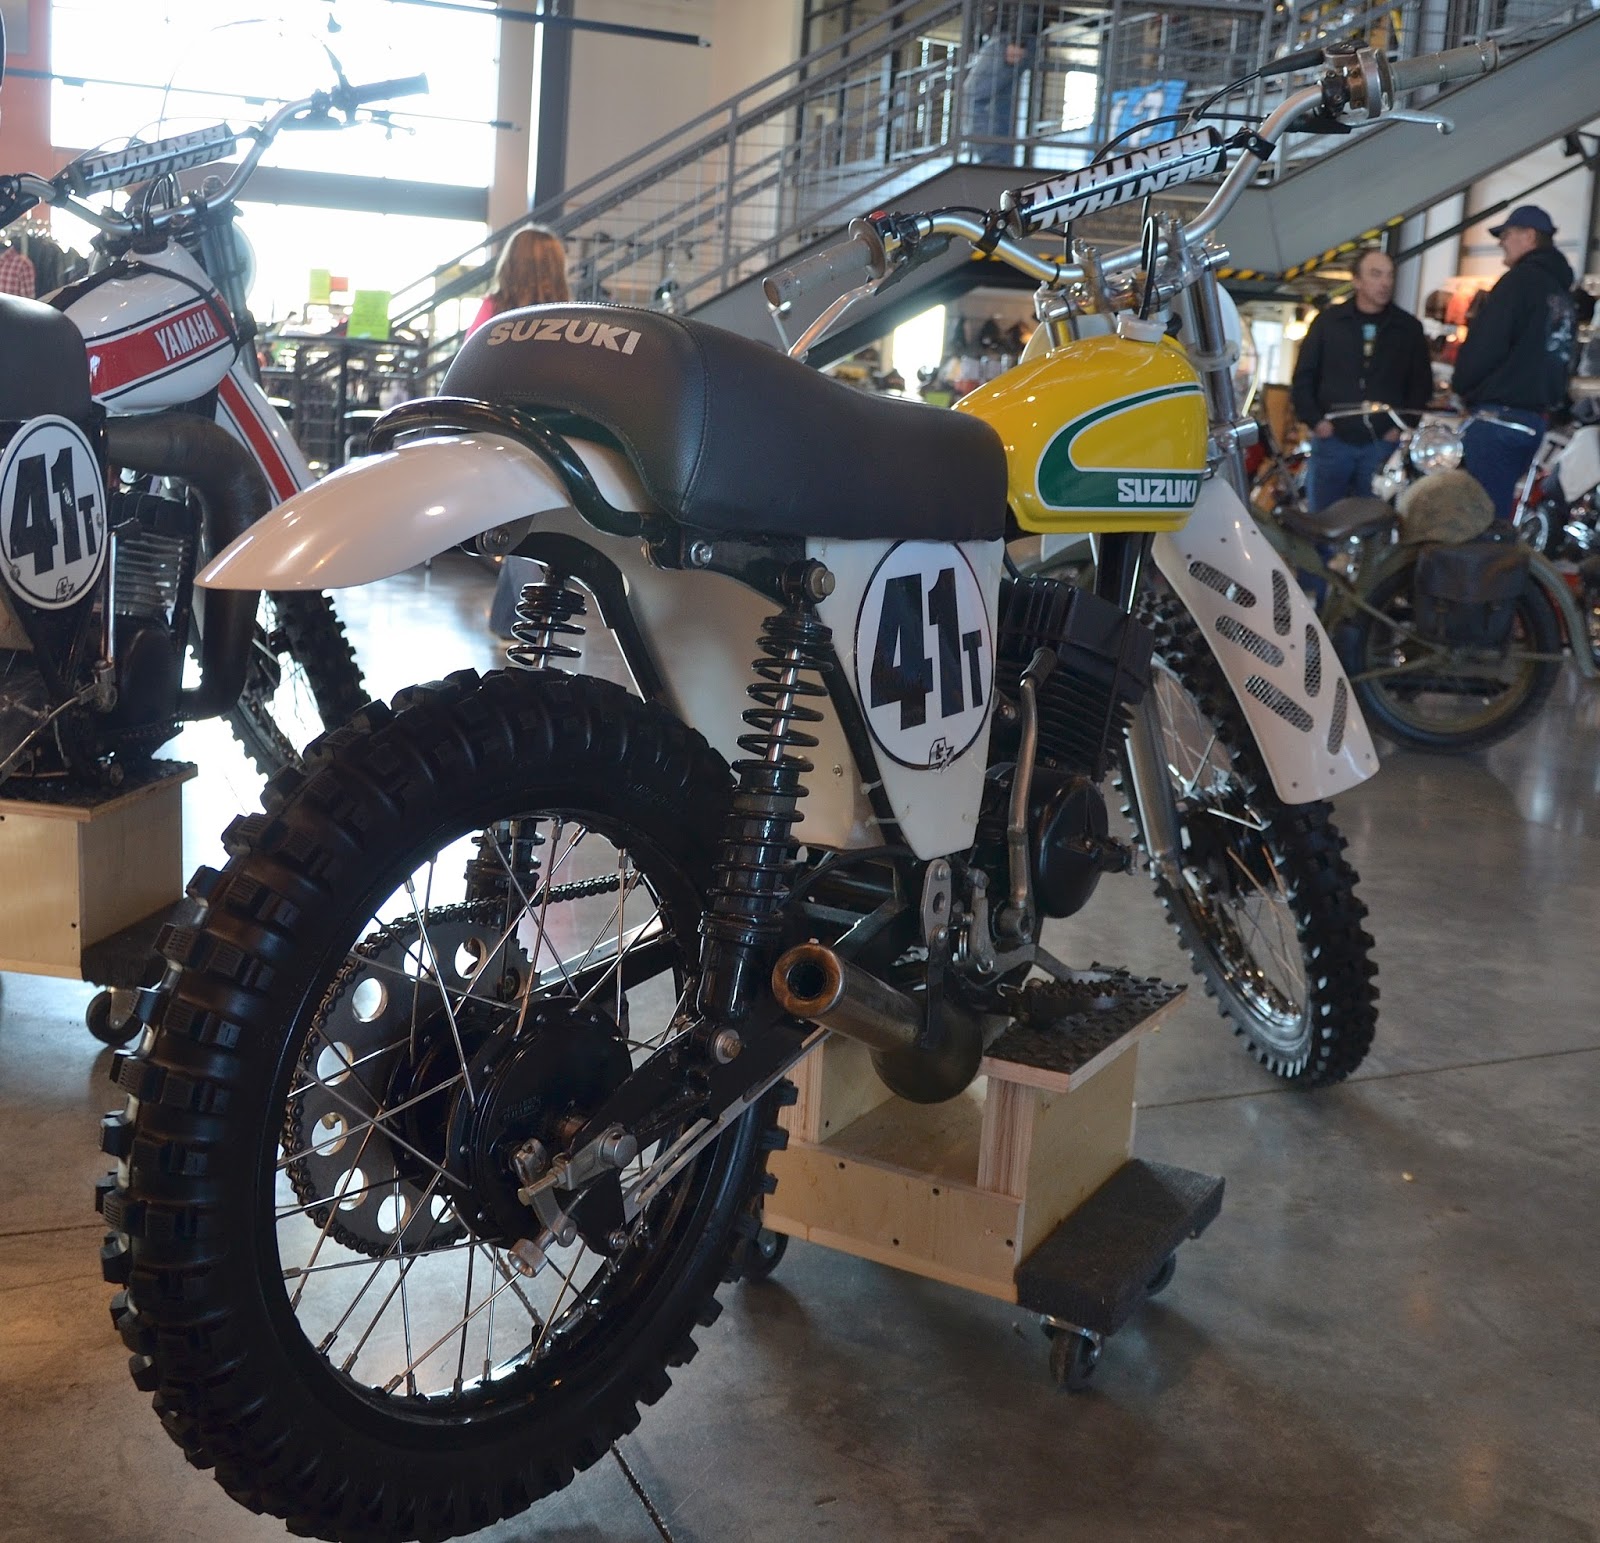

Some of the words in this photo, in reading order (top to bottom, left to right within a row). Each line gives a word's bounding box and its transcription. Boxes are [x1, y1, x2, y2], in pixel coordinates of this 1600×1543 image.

[84, 125, 225, 177] RENTHAL
[1021, 129, 1212, 205] RENTHAL
[1031, 153, 1220, 231] RENTHAL
[154, 309, 218, 361] YAMAHA
[487, 318, 642, 356] SUZUKI
[1117, 478, 1198, 503] SUZUKI
